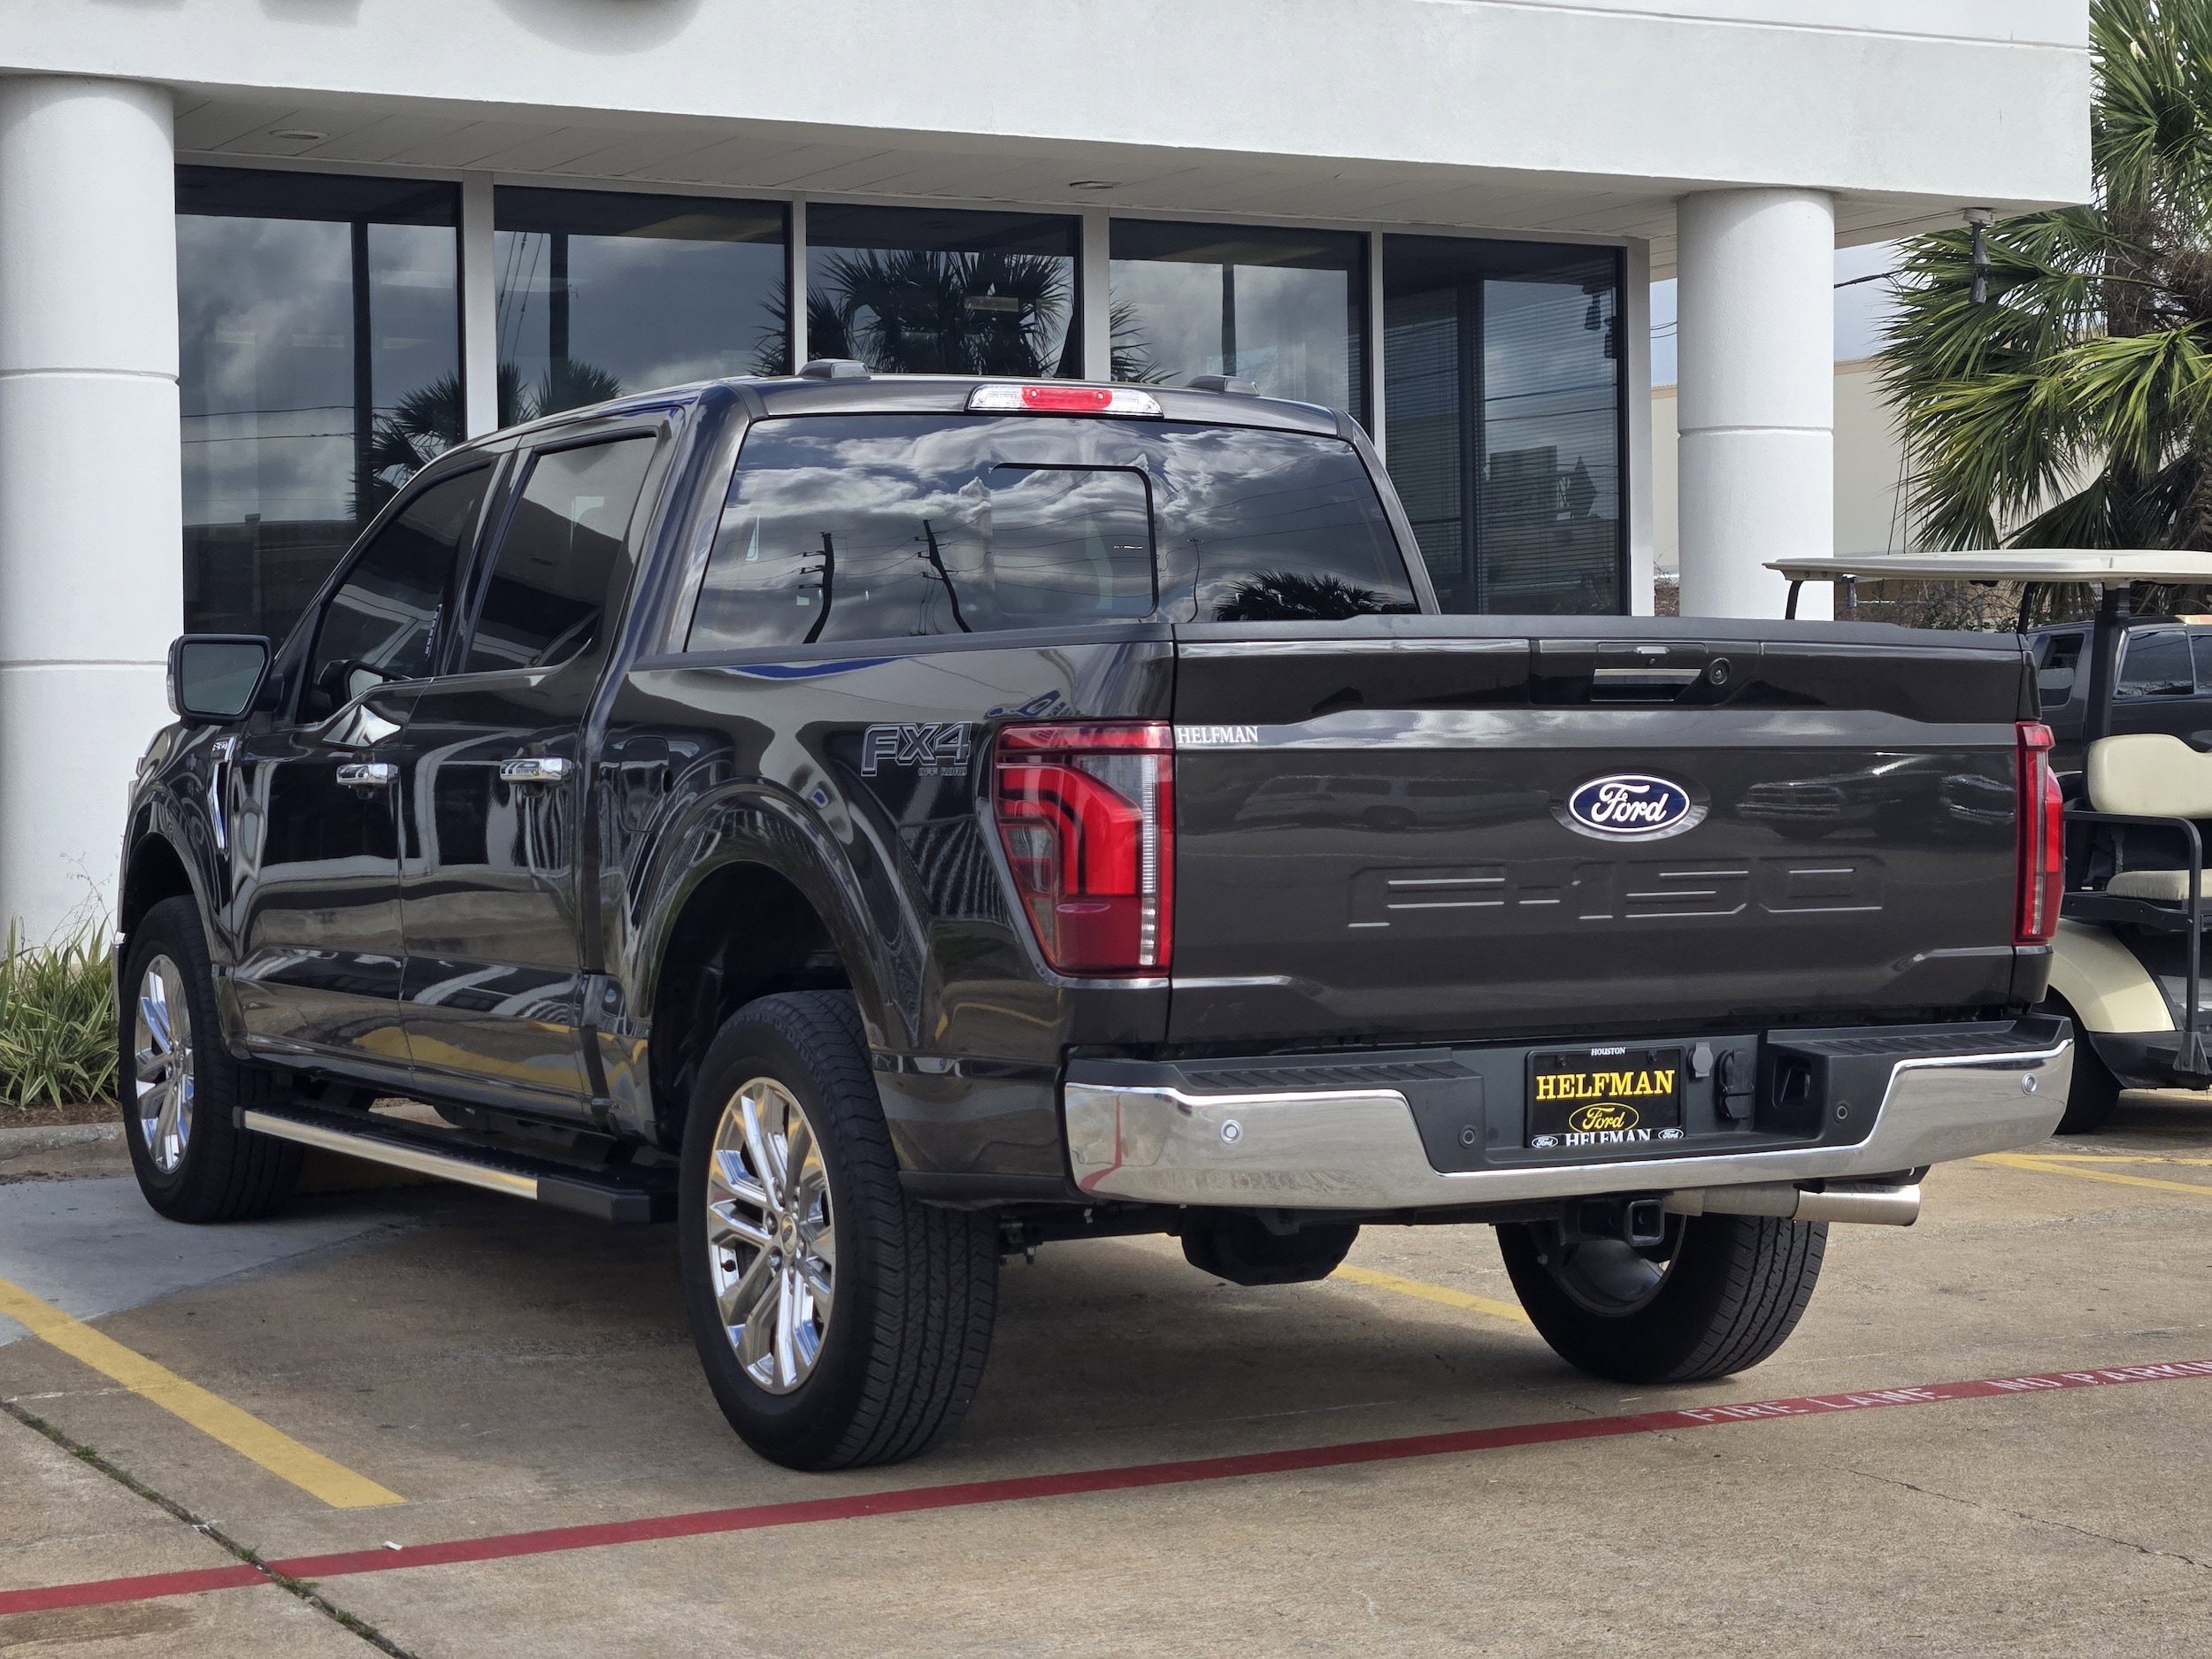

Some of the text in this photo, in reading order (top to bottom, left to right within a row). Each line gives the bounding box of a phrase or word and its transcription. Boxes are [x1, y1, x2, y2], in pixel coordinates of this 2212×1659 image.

[861, 720, 972, 777] FX4
[1177, 726, 1258, 744] HELFMAN
[918, 767, 938, 777] OFF
[1591, 783, 1670, 823] Ford
[1591, 1047, 1626, 1056] HOUSTON
[1536, 1069, 1675, 1100] HELFMAN
[1582, 1106, 1626, 1131] Ford
[1678, 1402, 1809, 1422] FIRE
[1806, 1387, 1953, 1409] LANE
[1985, 1377, 2063, 1391] NO
